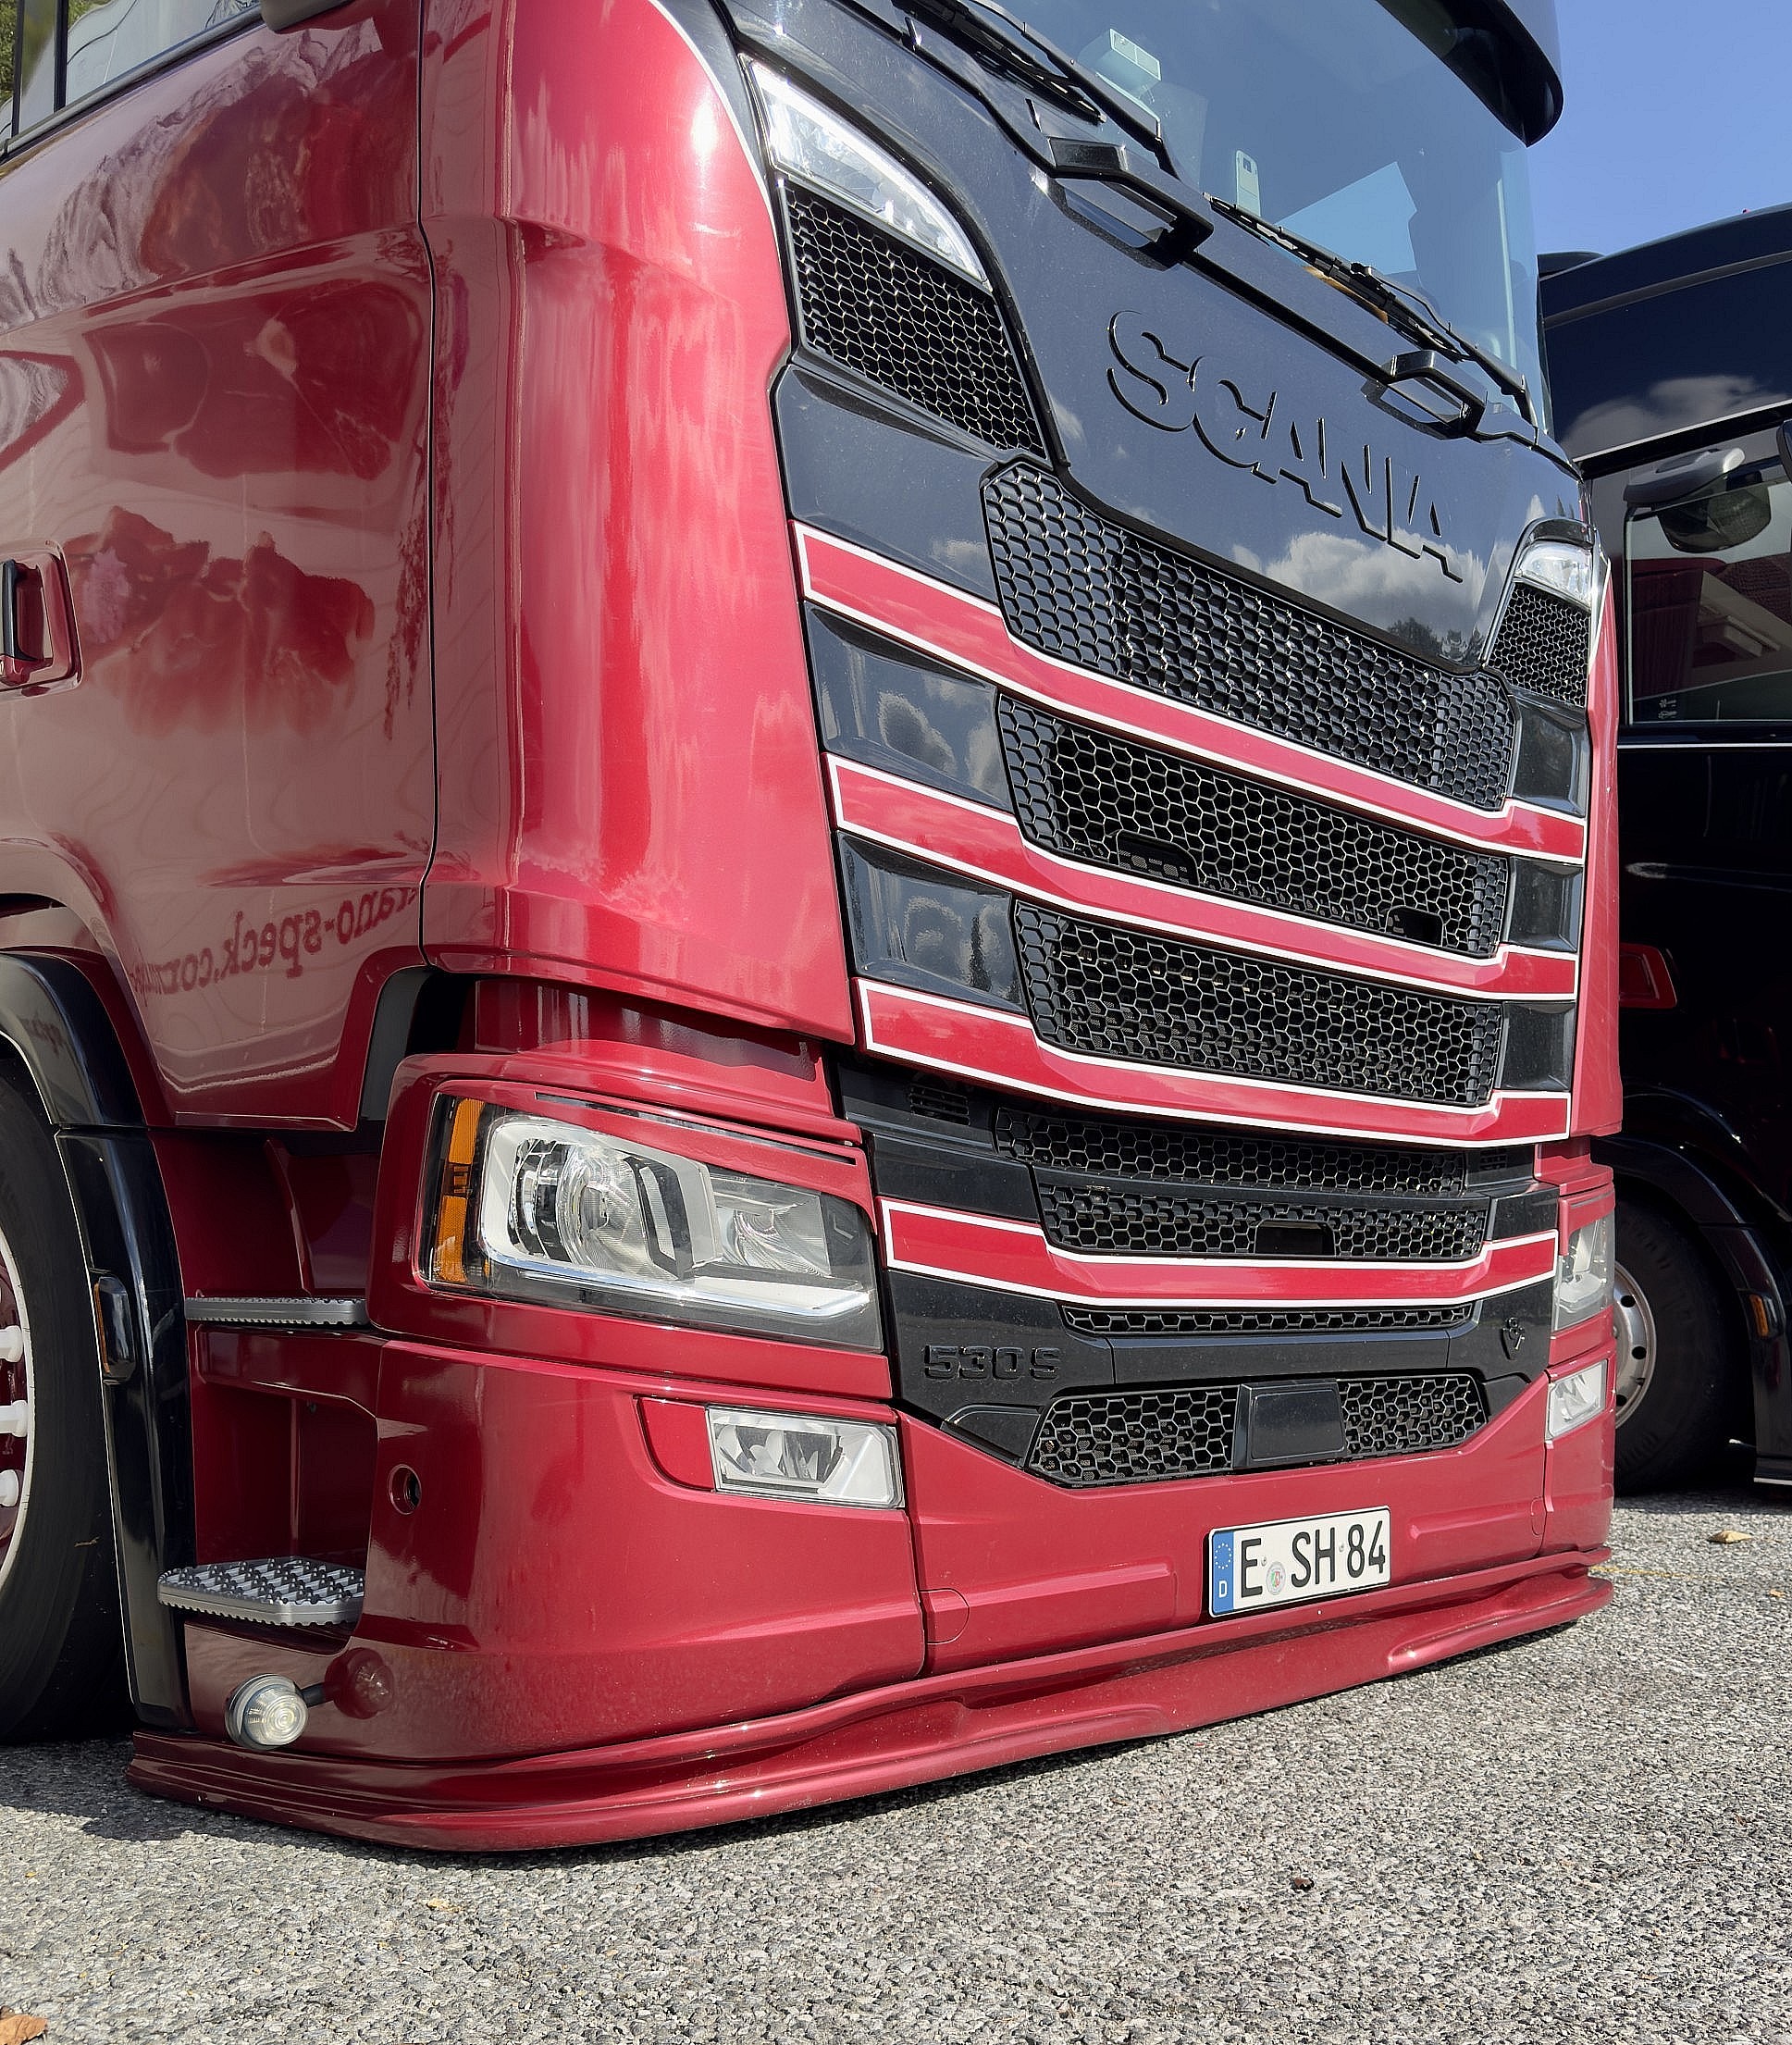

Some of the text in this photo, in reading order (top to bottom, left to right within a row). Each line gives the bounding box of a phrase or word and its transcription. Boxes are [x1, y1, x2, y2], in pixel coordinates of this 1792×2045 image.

[1106, 309, 1464, 585] SCANIA
[924, 1345, 1061, 1382] 530 S
[1241, 1520, 1386, 1598] E SH 84
[1218, 1580, 1228, 1598] D
